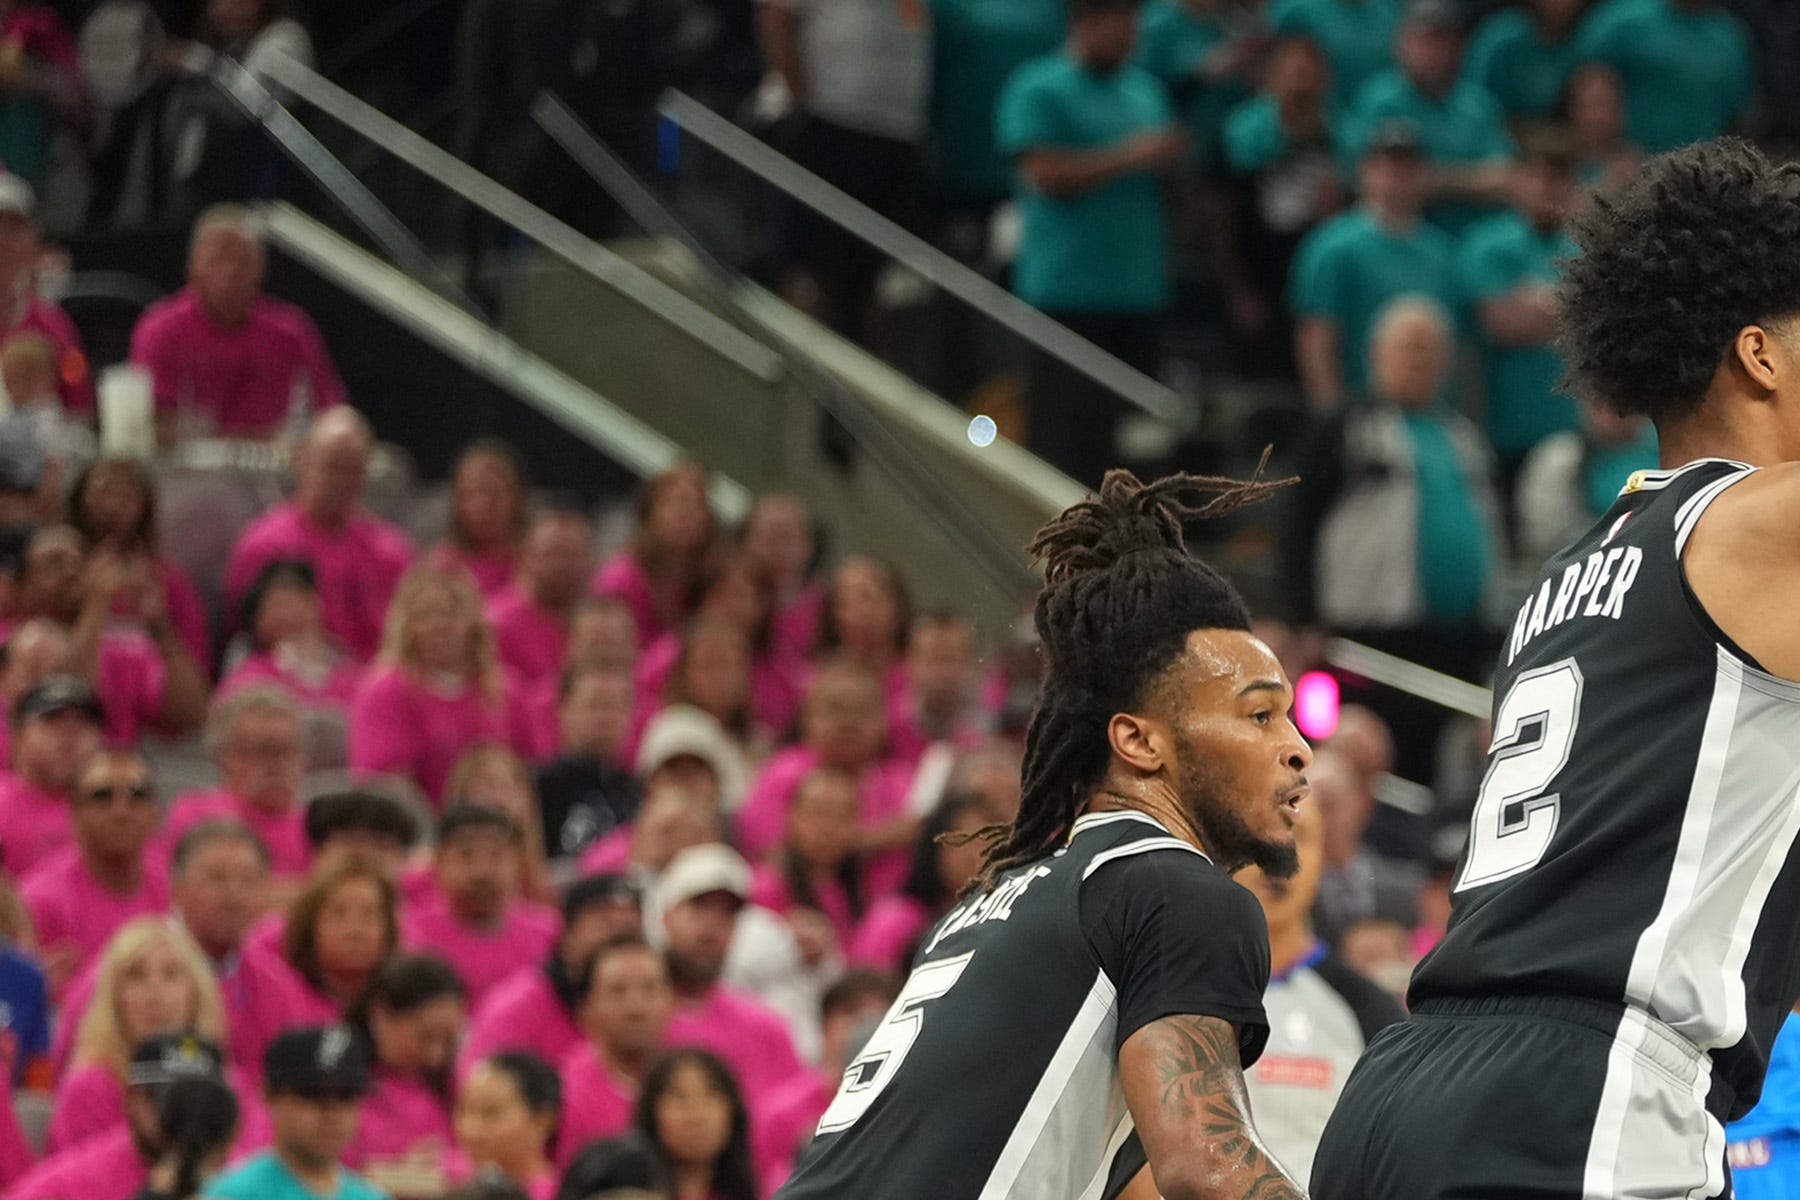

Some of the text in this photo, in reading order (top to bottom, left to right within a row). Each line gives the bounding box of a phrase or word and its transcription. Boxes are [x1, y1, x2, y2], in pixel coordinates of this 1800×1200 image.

[1507, 546, 1643, 667] HARPER
[1453, 656, 1584, 893] 2
[815, 949, 976, 1137] 5
